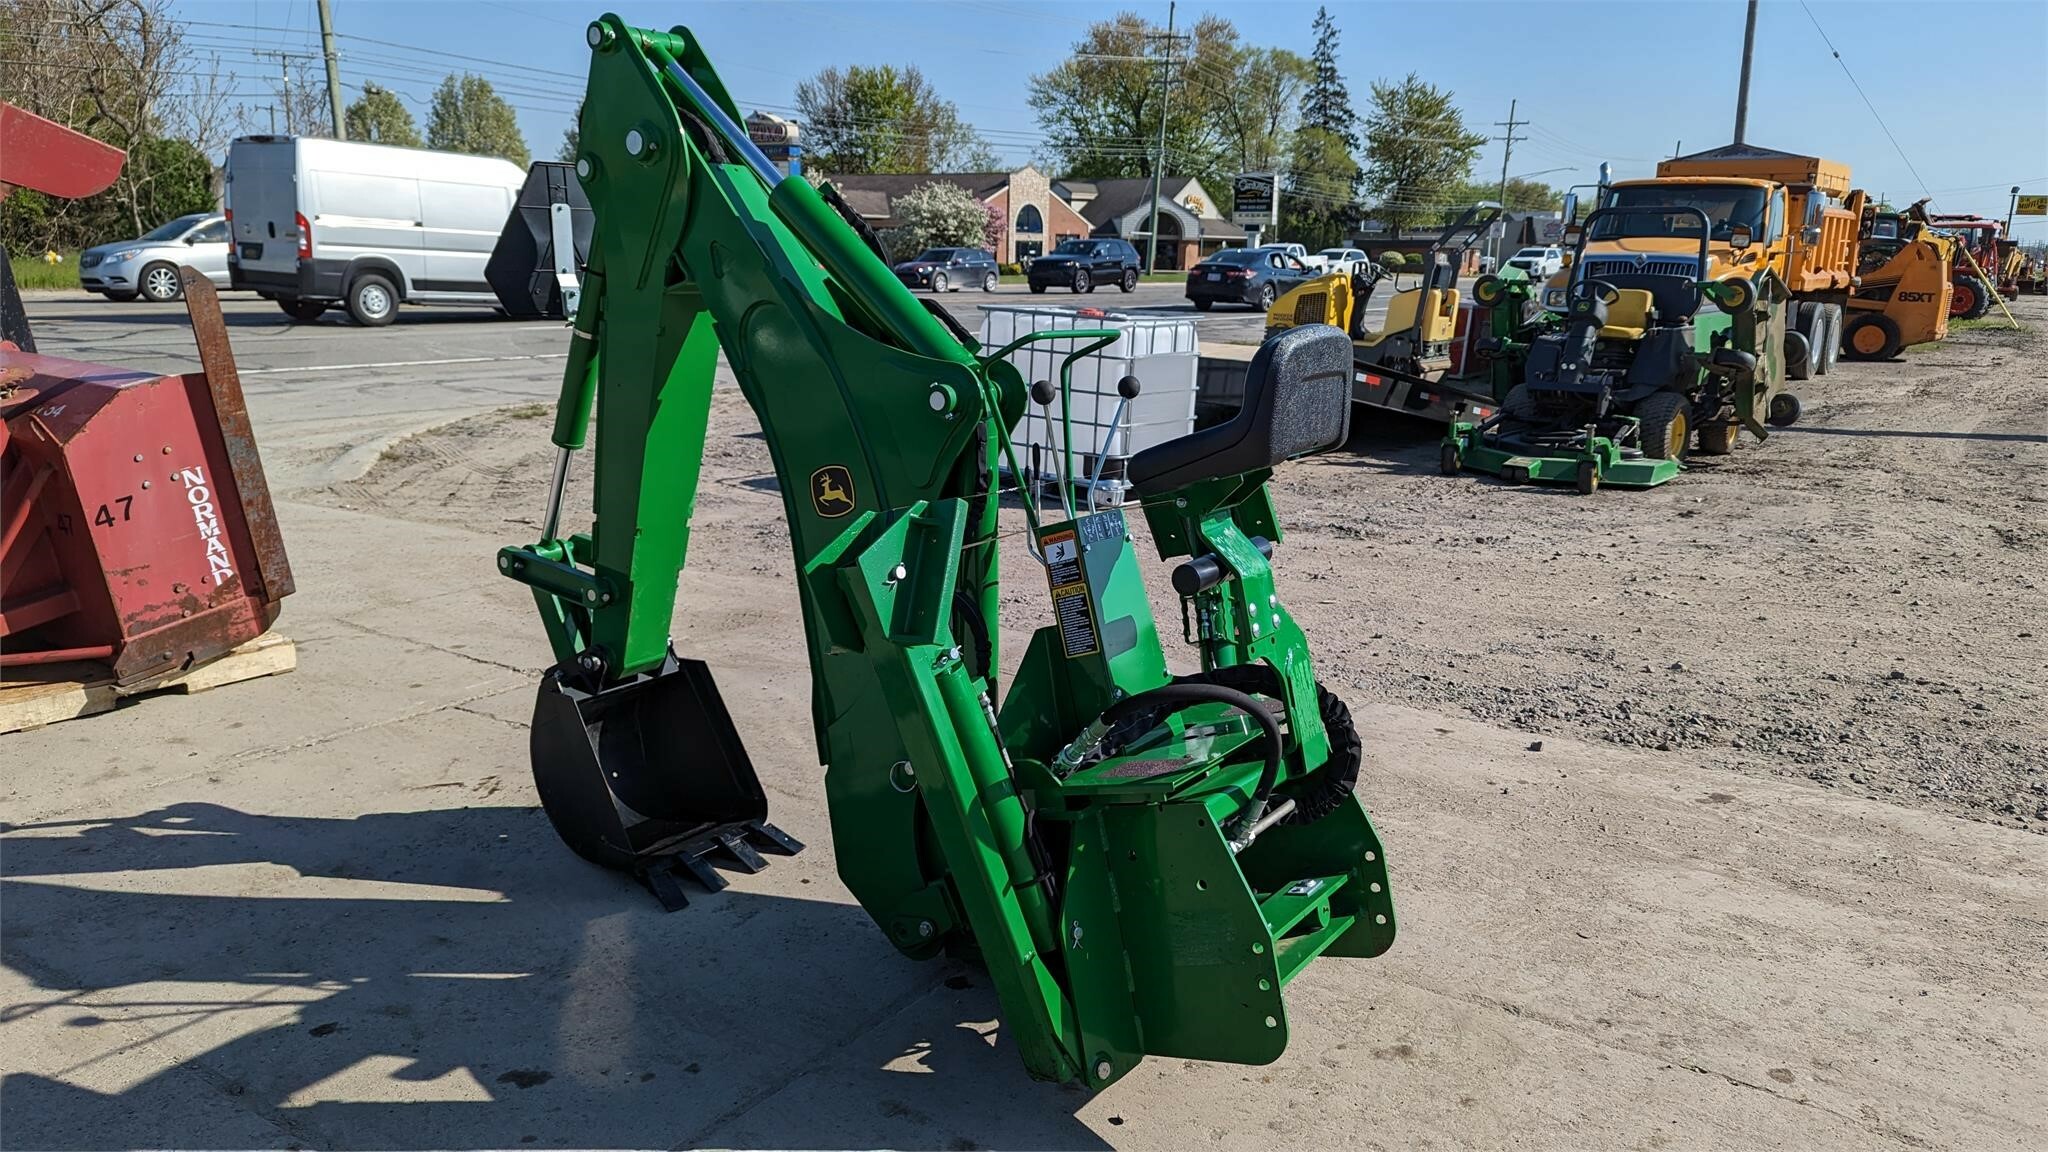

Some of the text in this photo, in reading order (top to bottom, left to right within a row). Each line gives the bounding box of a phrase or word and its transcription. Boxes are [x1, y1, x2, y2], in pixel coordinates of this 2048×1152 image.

[1898, 291, 1936, 303] 85XT
[95, 495, 133, 528] 47
[57, 513, 73, 536] 47
[1049, 532, 1074, 543] WARNING
[1060, 586, 1085, 596] CAUTION
